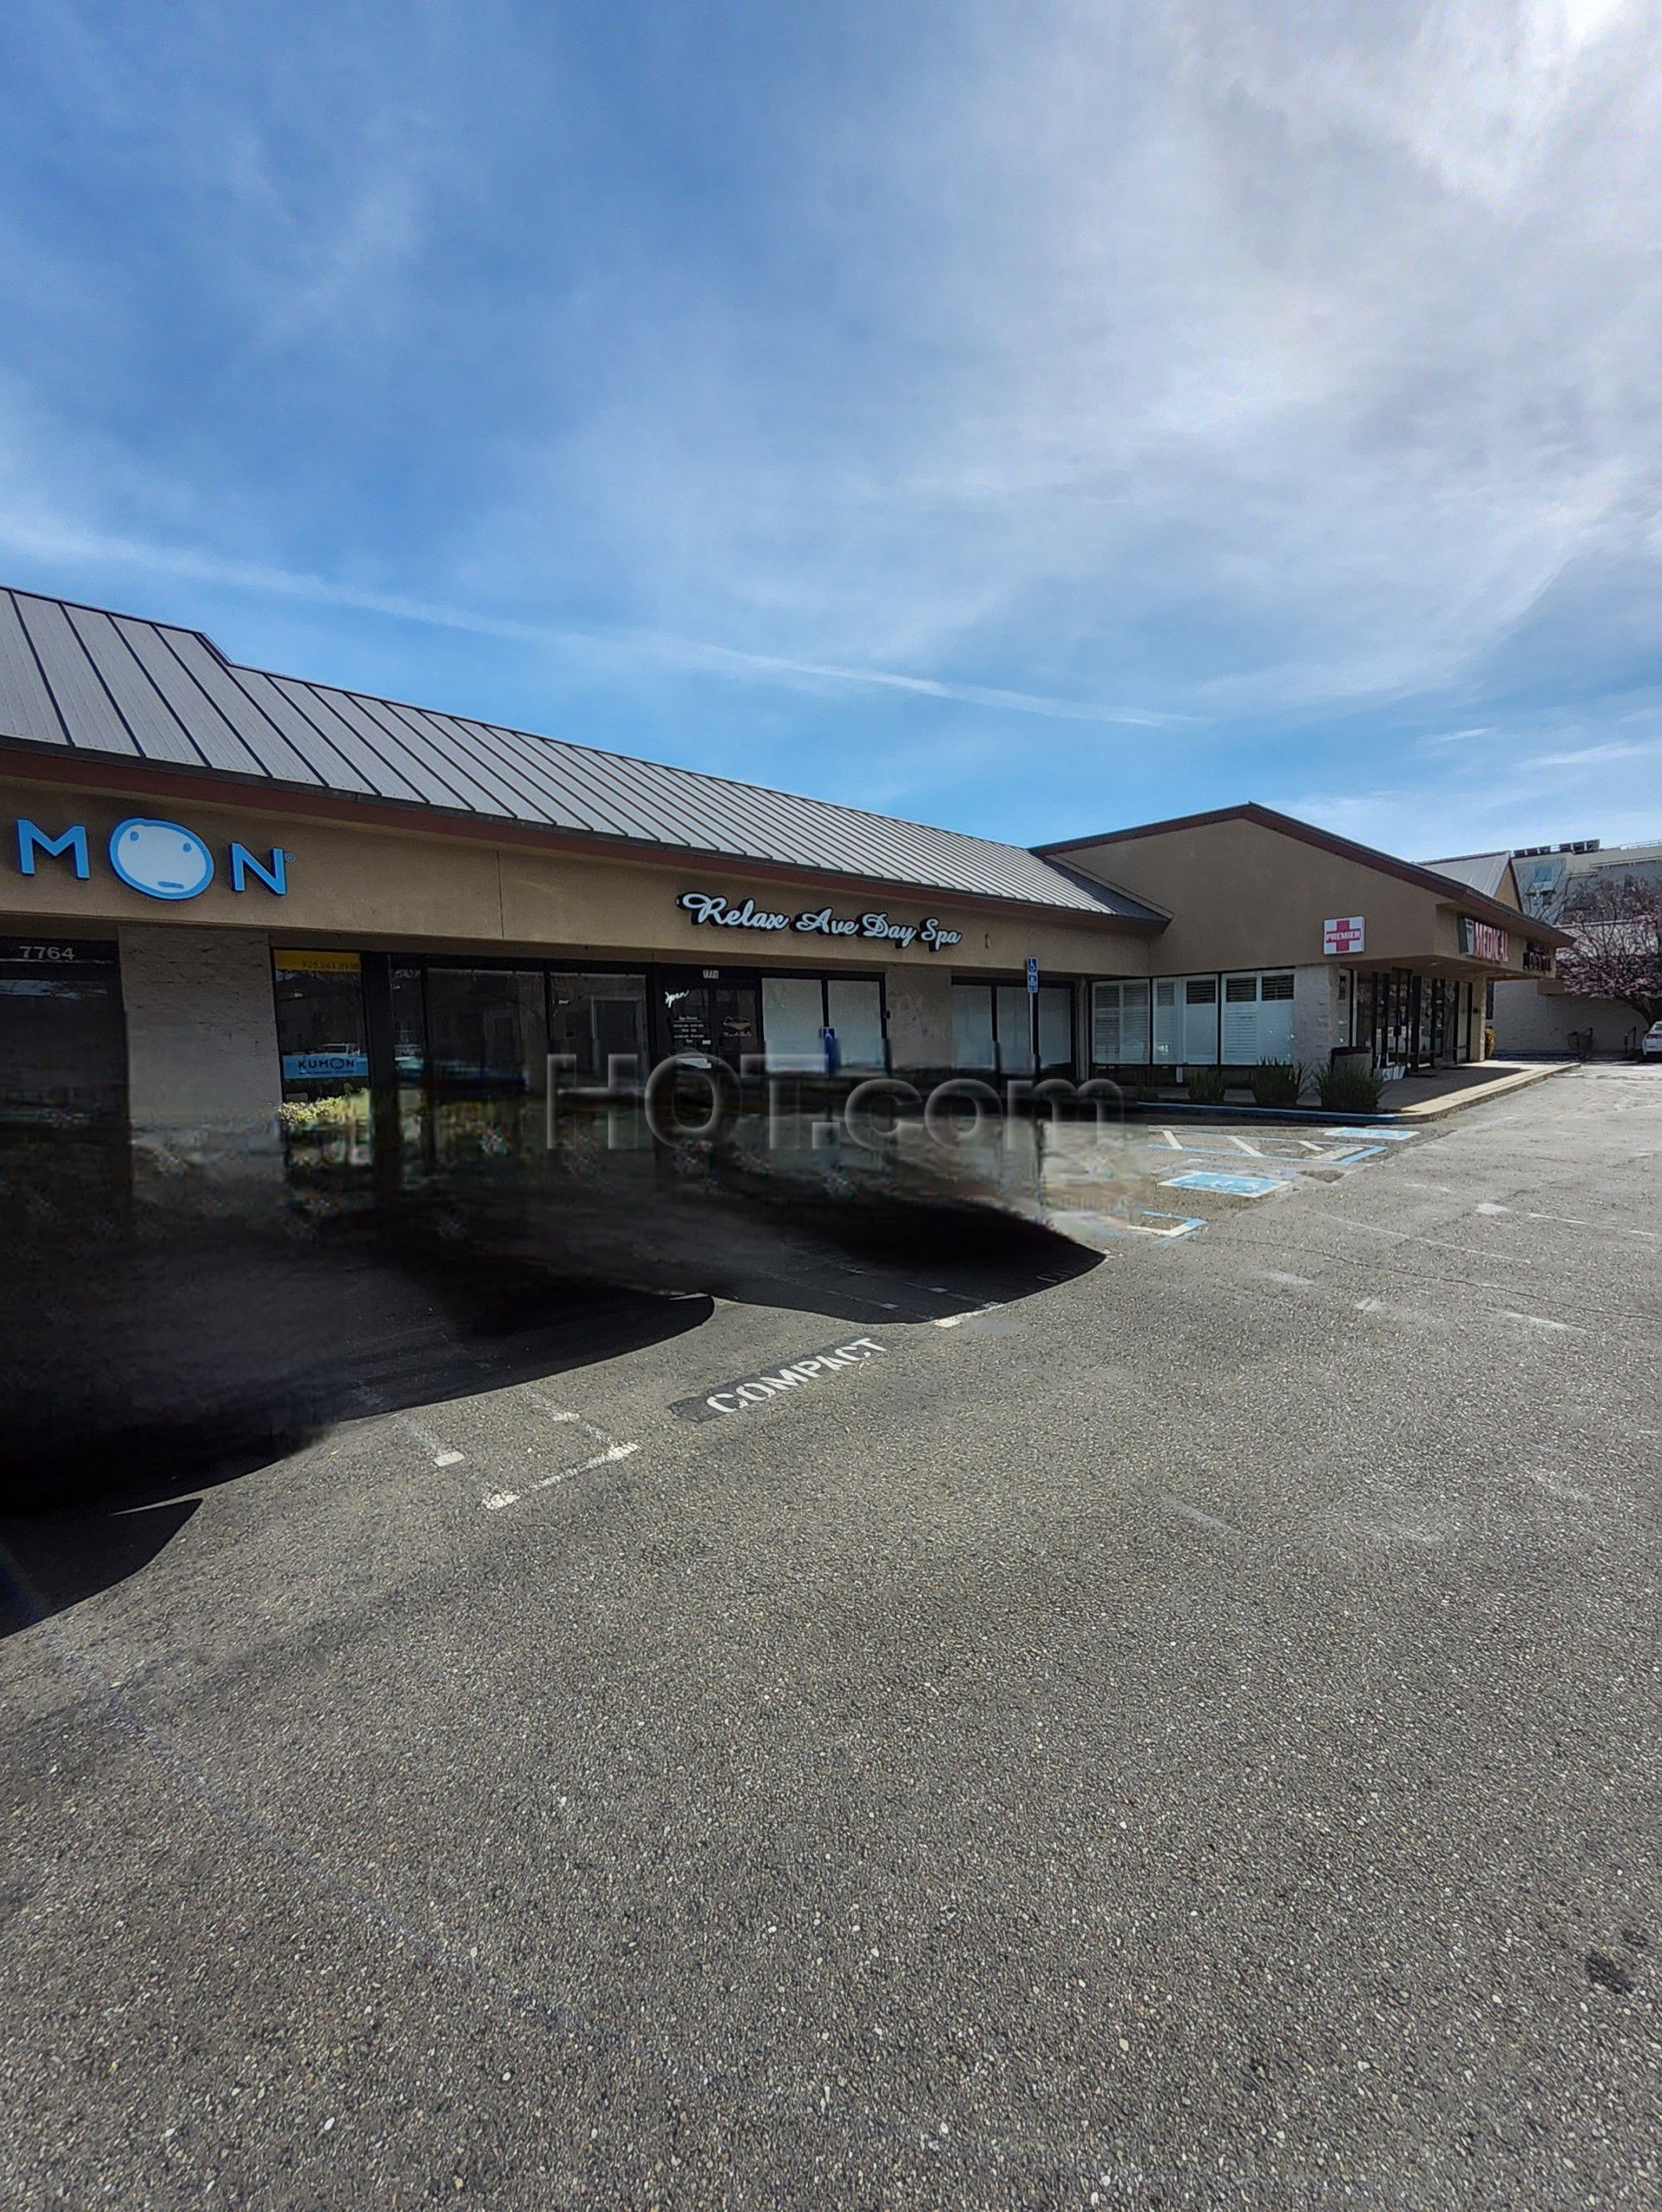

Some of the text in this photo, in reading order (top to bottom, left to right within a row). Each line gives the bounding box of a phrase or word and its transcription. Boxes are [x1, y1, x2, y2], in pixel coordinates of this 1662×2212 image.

[682, 893, 963, 950] Relax Ave Day Spa
[1326, 930, 1360, 942] PREMIER
[19, 945, 75, 960] 7764
[298, 1057, 355, 1069] KUMON
[706, 1338, 888, 1413] COMPACT
